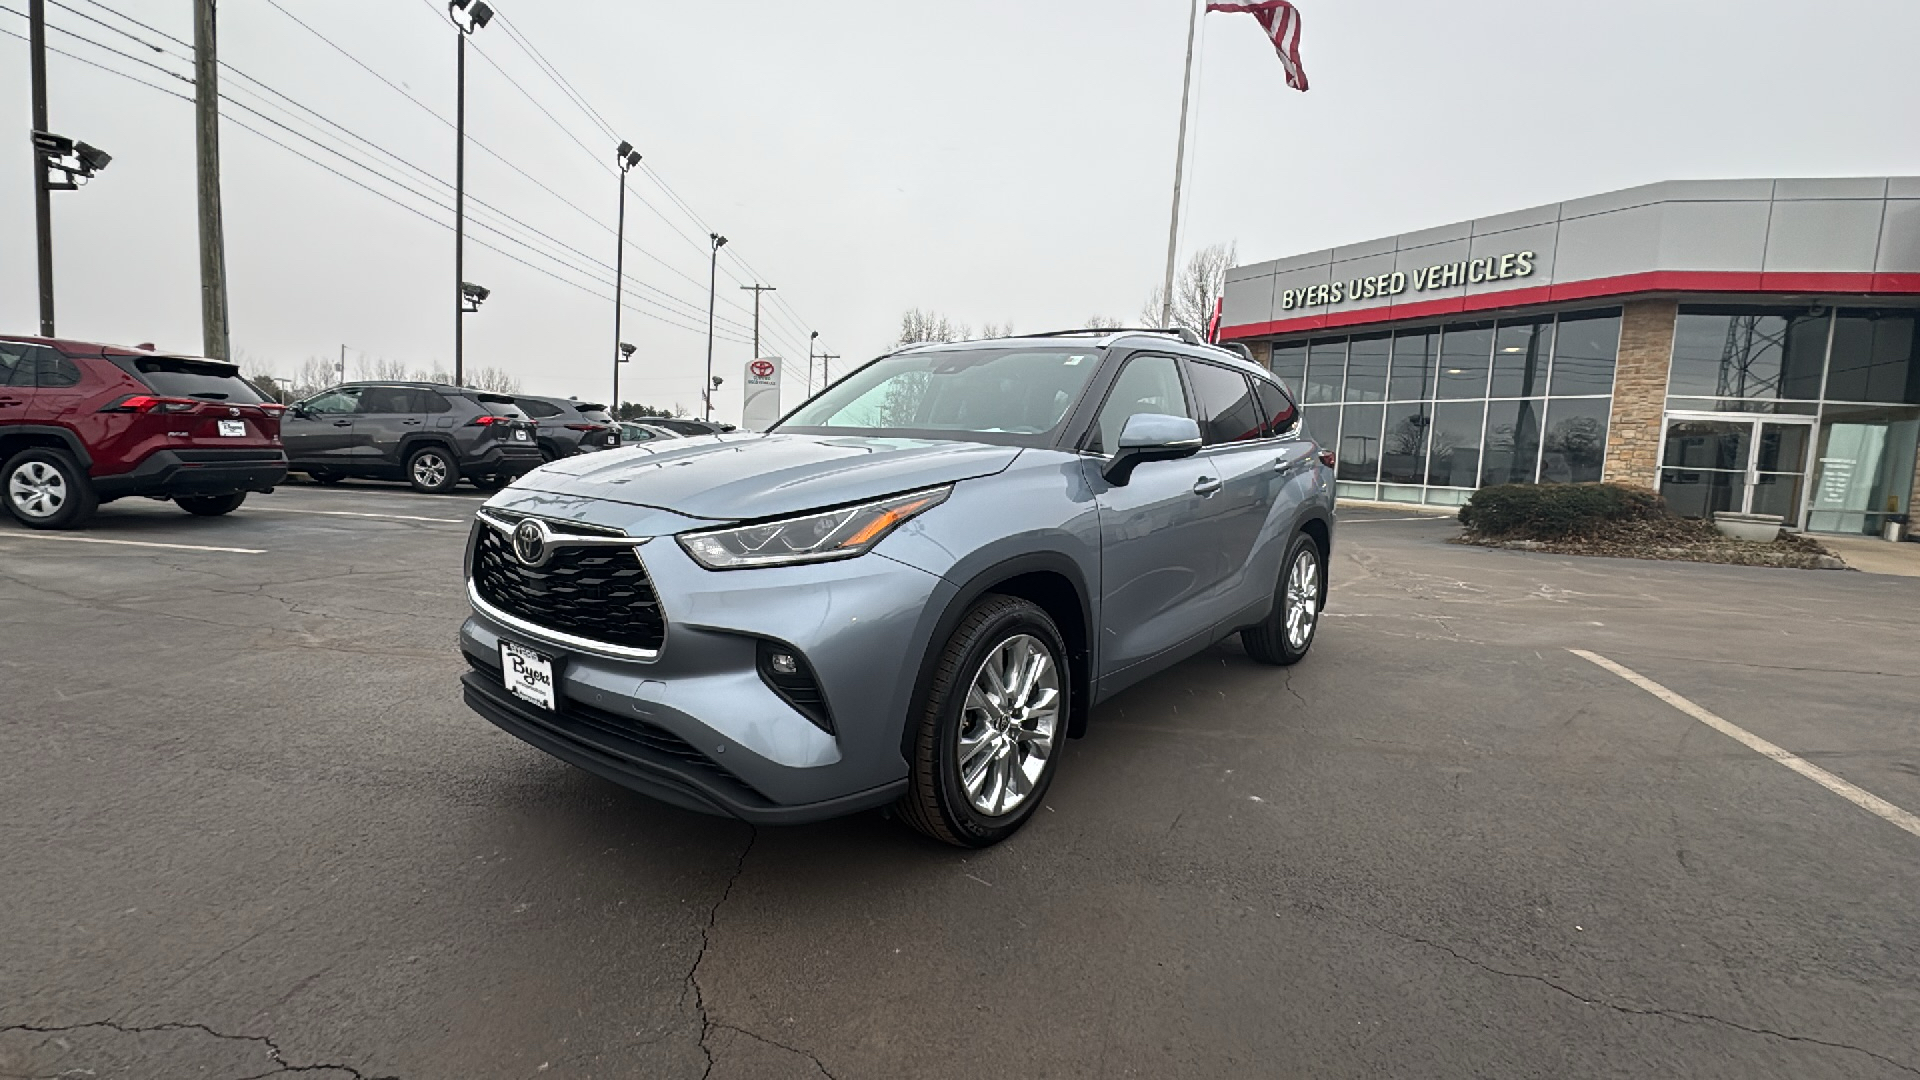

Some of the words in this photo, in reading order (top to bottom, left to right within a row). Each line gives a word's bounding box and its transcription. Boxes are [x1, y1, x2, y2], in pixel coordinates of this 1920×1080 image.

[1282, 281, 1344, 310] BYERS
[1349, 272, 1406, 300] USED
[1413, 251, 1535, 291] VEHICLES
[506, 652, 551, 686] Byers
